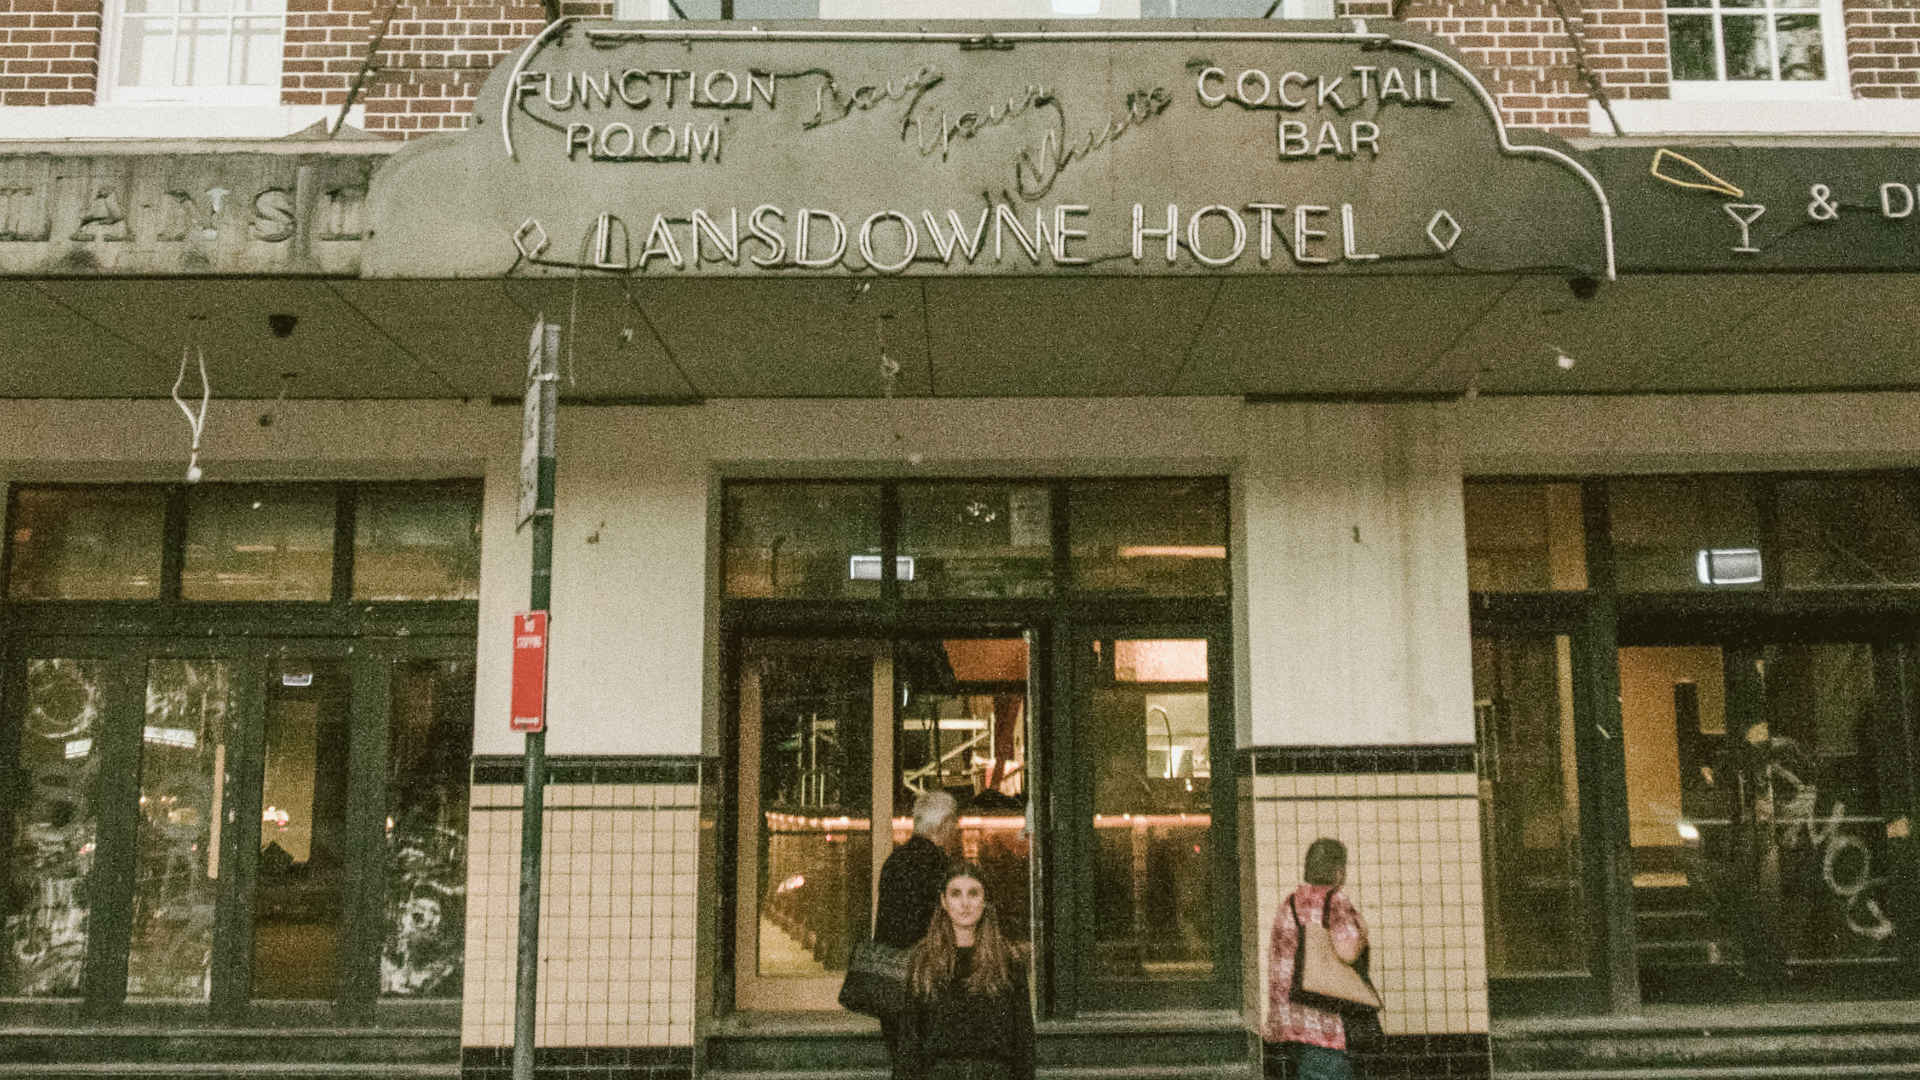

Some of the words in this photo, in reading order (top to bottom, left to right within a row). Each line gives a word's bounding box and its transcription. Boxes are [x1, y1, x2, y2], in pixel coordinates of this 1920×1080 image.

[516, 69, 775, 108] FUNCTION
[1197, 66, 1454, 110] COCKTAIL
[566, 121, 721, 161] ROOM
[1278, 120, 1380, 160] BAR
[595, 204, 1091, 270] LANSDOWNE
[1132, 202, 1381, 266] HOTEL
